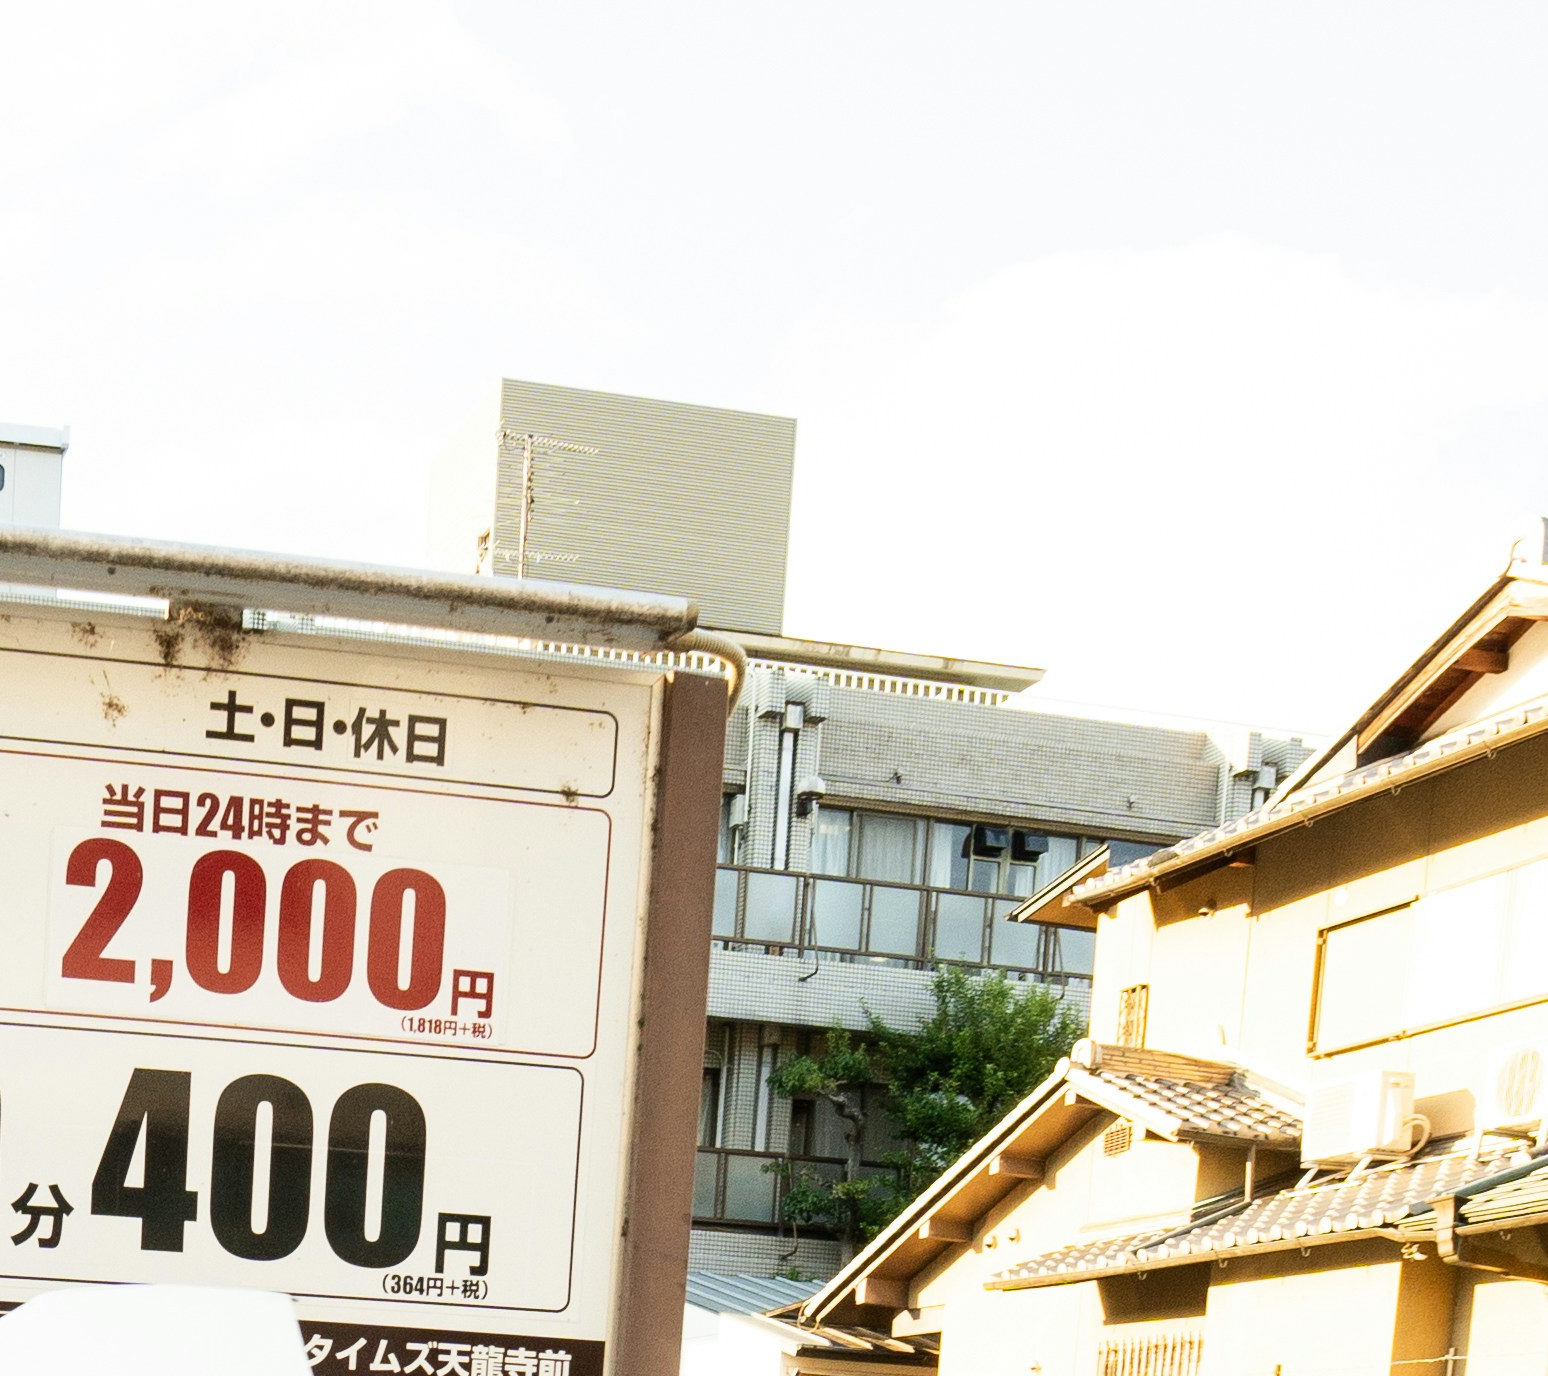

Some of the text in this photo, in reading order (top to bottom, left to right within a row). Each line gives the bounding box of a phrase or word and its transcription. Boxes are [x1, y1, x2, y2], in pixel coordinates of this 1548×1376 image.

[100, 782, 381, 852] 当日24時まで
